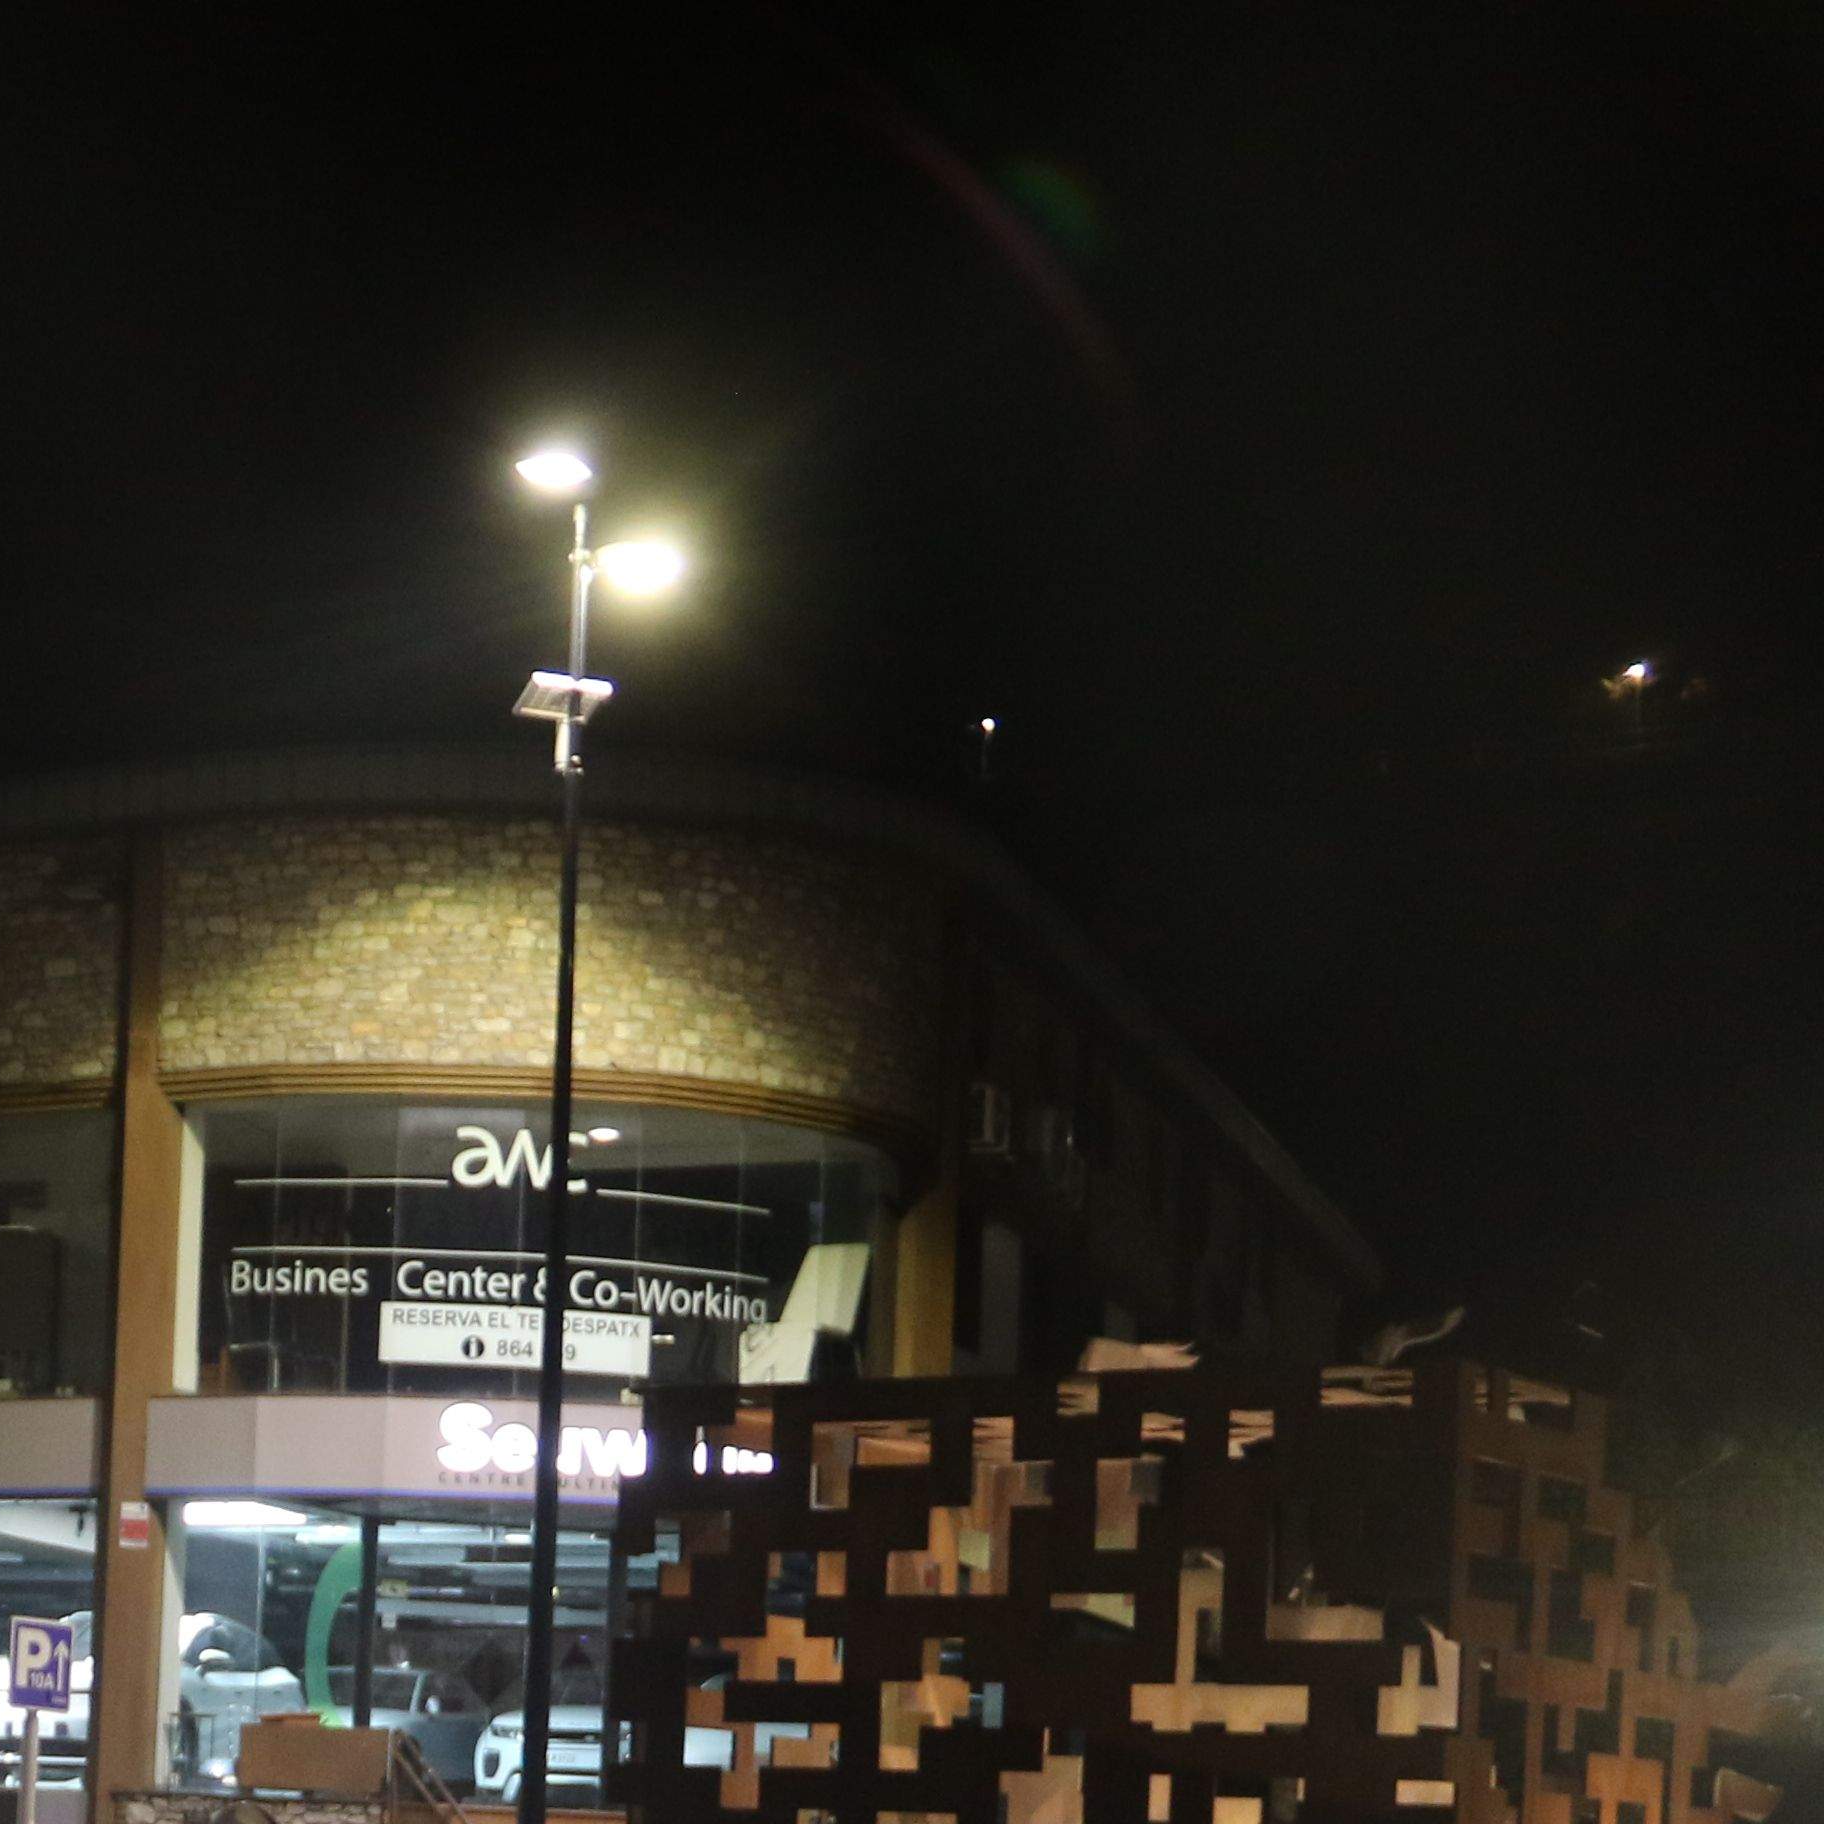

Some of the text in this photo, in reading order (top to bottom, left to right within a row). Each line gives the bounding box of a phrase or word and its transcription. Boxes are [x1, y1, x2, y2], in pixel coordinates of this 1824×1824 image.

[230, 1259, 369, 1295] Busines
[397, 1260, 527, 1300] Center
[569, 1269, 768, 1323] Co-Working
[392, 1307, 482, 1328] RESERVA
[488, 1311, 510, 1329] EL
[517, 1312, 540, 1331] TE
[497, 1339, 534, 1358] 864
[16, 1625, 52, 1689] P
